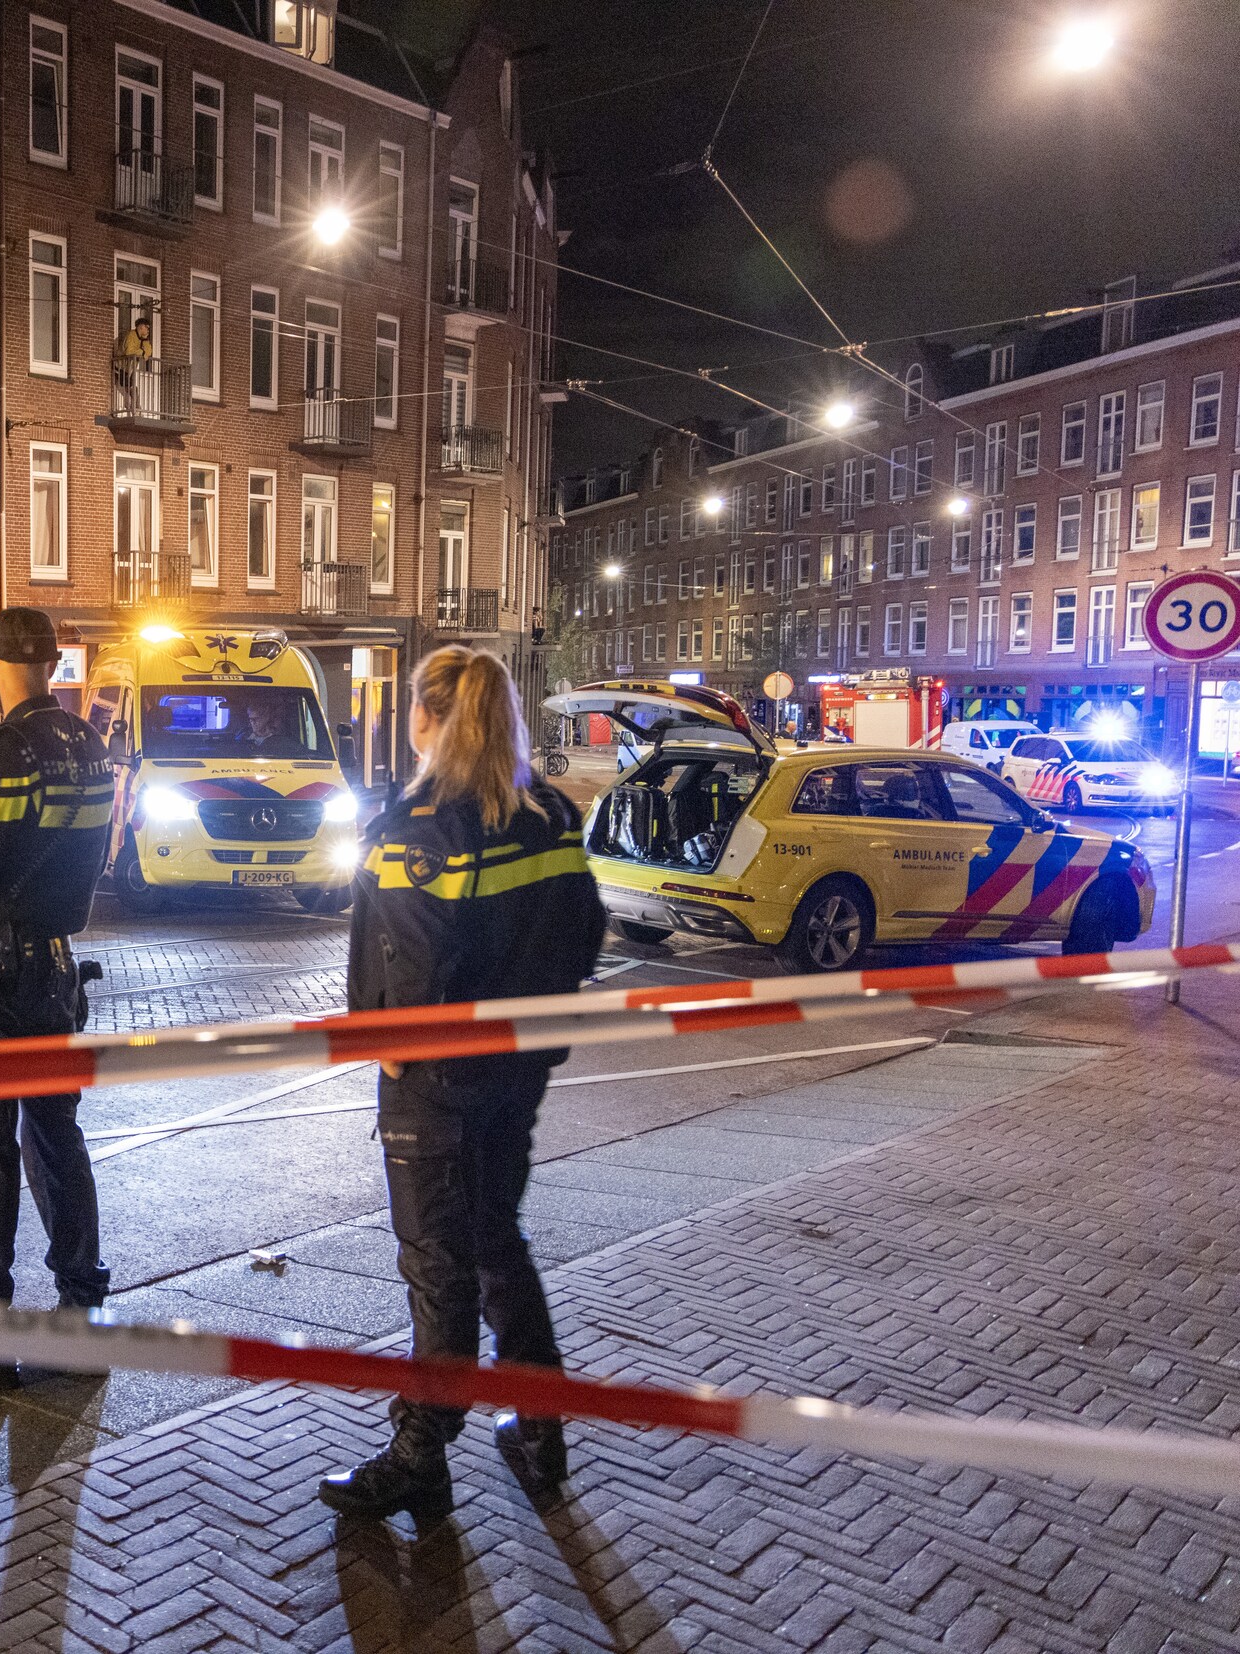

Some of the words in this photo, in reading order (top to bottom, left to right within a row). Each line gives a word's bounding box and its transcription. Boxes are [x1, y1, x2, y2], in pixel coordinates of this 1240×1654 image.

[1165, 600, 1228, 633] 30
[773, 843, 812, 856] 13-901
[893, 849, 965, 862] AMBULANCE
[241, 872, 290, 883] J-209-KG
